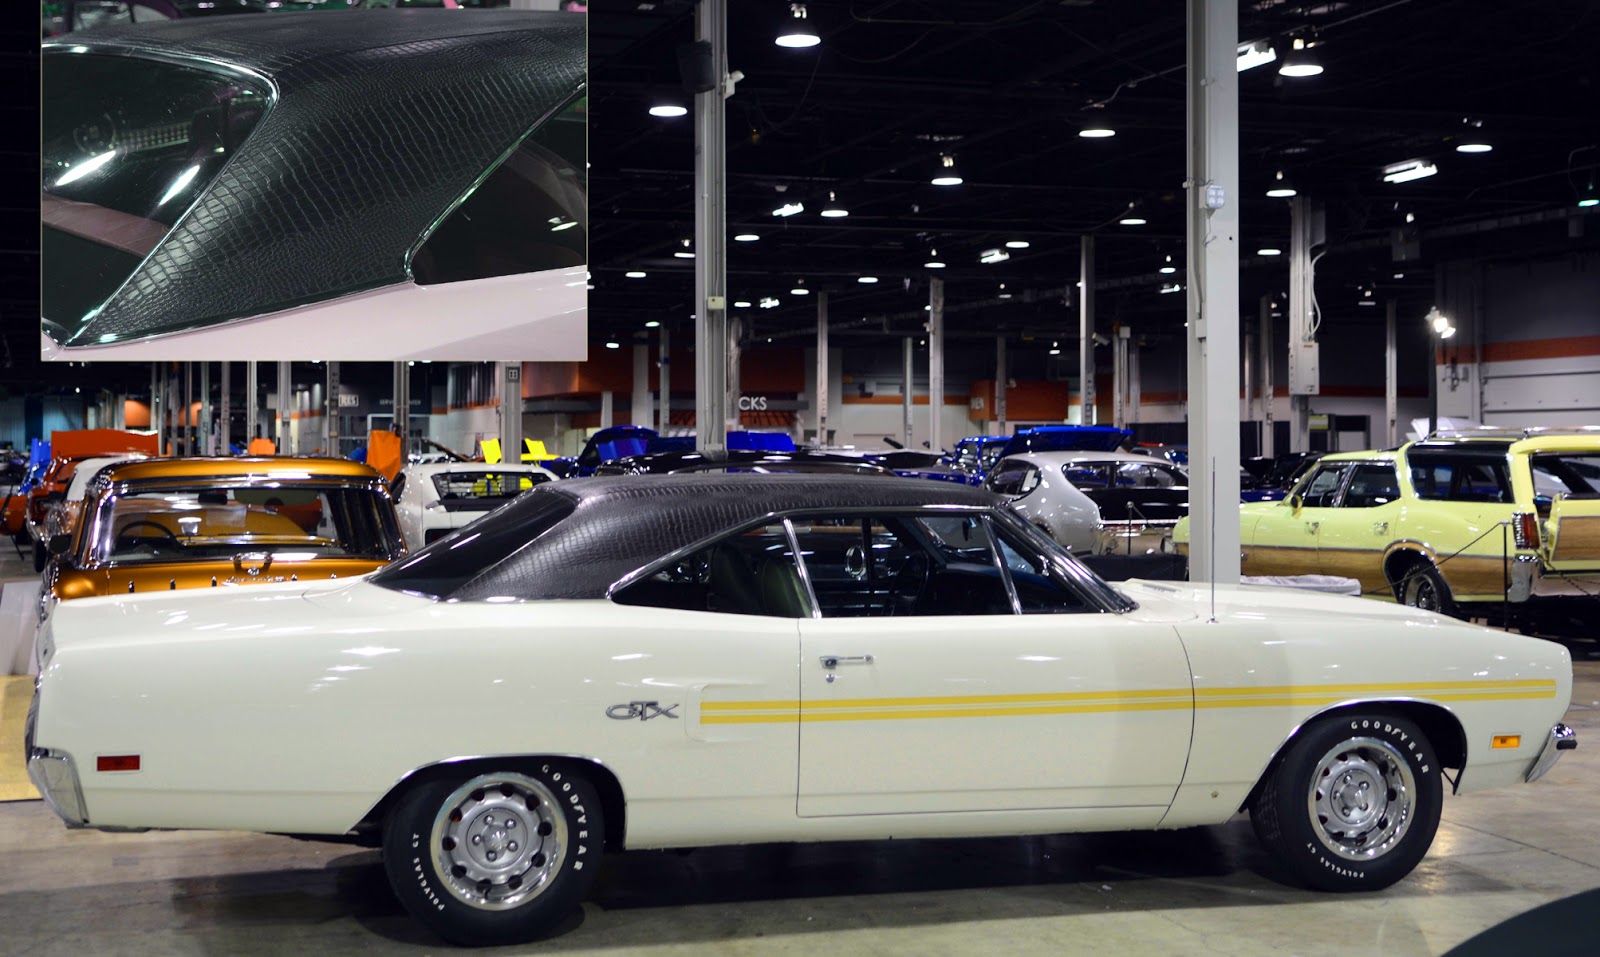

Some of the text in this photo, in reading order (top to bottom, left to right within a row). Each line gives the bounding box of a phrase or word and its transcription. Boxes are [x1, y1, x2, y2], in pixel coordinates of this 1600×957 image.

[738, 396, 767, 411] CKS
[605, 701, 679, 721] GTX
[1351, 719, 1429, 774] GOODYEAR
[541, 763, 589, 872] GOODYEAR
